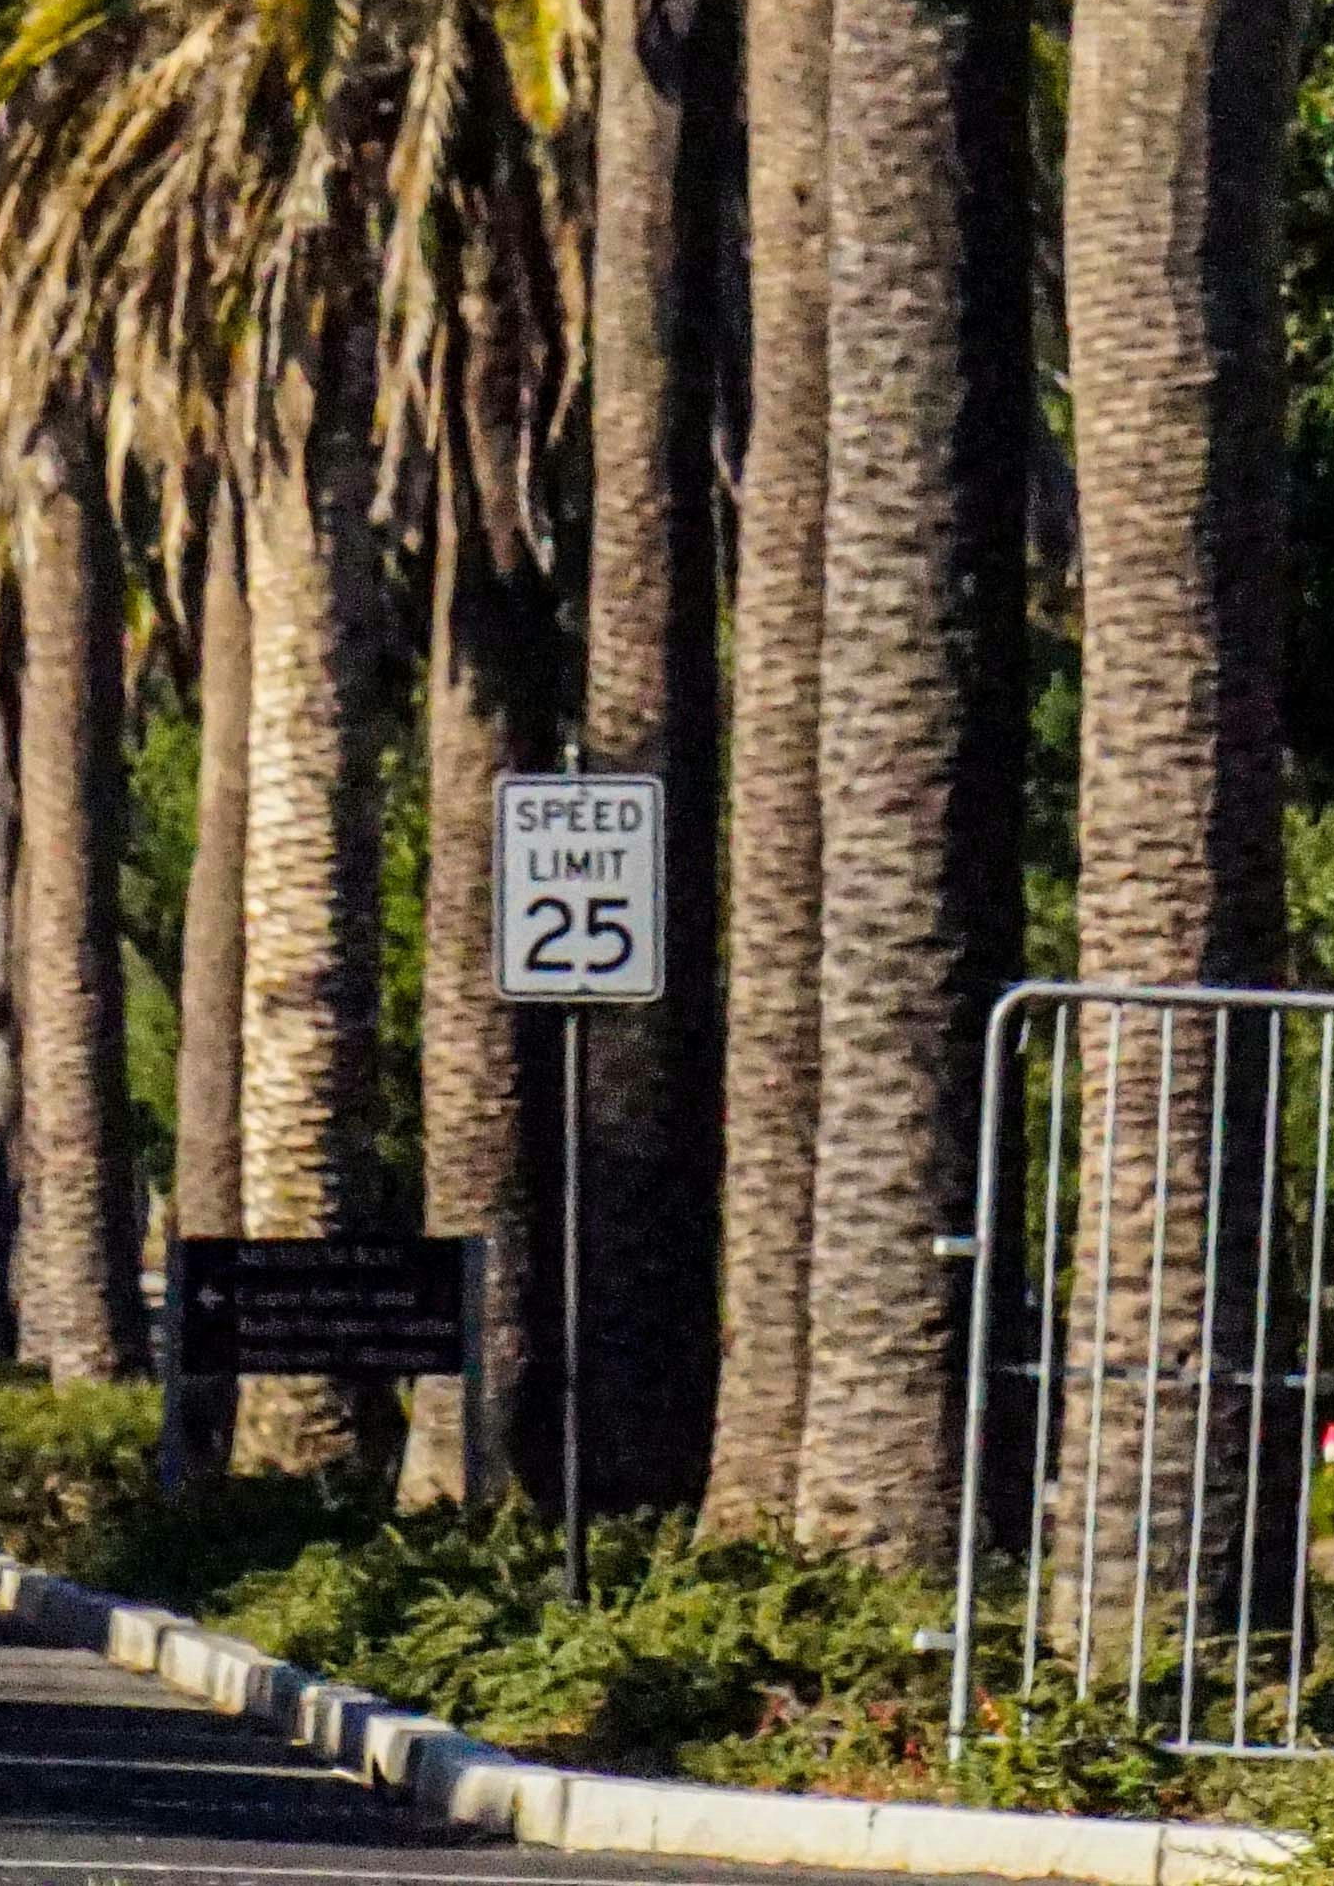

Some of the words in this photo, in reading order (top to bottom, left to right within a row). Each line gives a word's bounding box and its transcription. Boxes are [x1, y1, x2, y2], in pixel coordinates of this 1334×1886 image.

[517, 799, 643, 832] SPEED
[528, 848, 626, 881] LIMIT
[525, 897, 634, 974] 25
